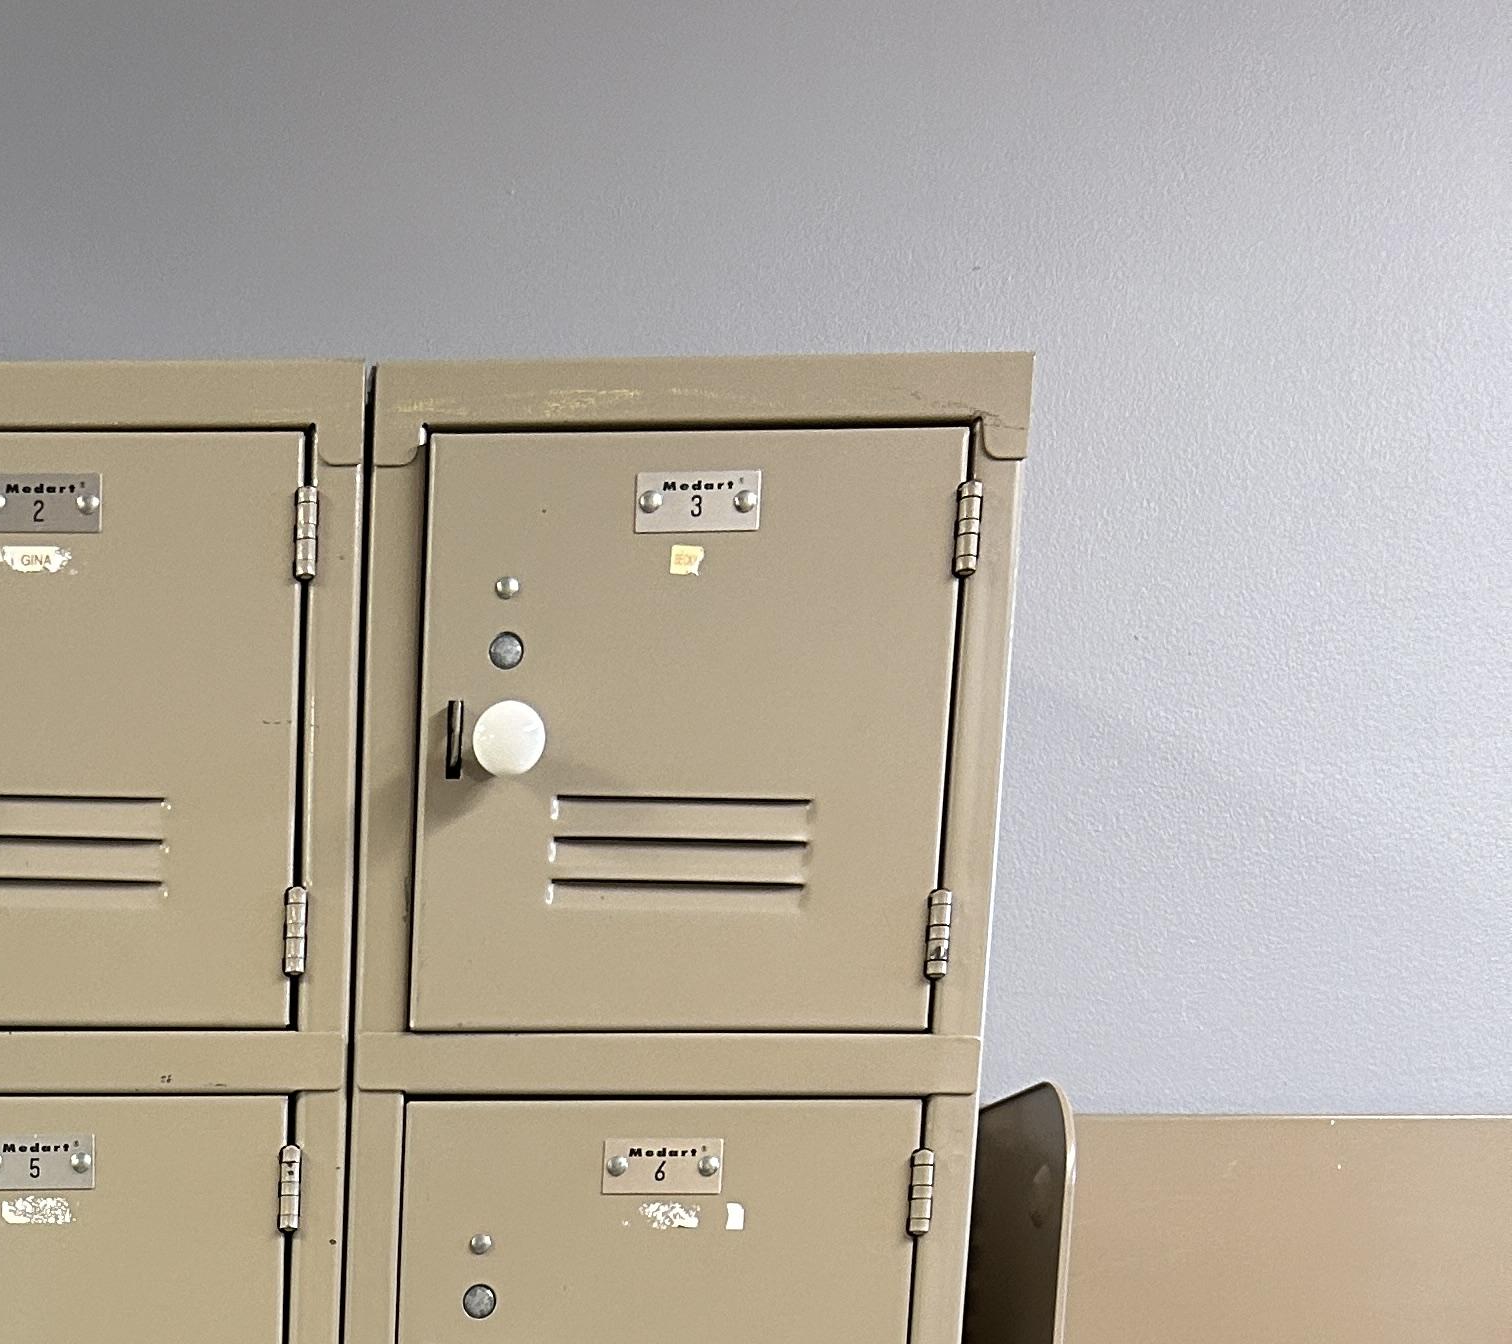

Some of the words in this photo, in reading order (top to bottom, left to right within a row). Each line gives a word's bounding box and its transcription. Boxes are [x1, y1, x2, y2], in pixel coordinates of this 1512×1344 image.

[34, 500, 44, 522] 2
[691, 495, 702, 517] 3
[21, 554, 52, 566] GINA
[30, 1158, 39, 1178] 5
[655, 1161, 666, 1181] 6
